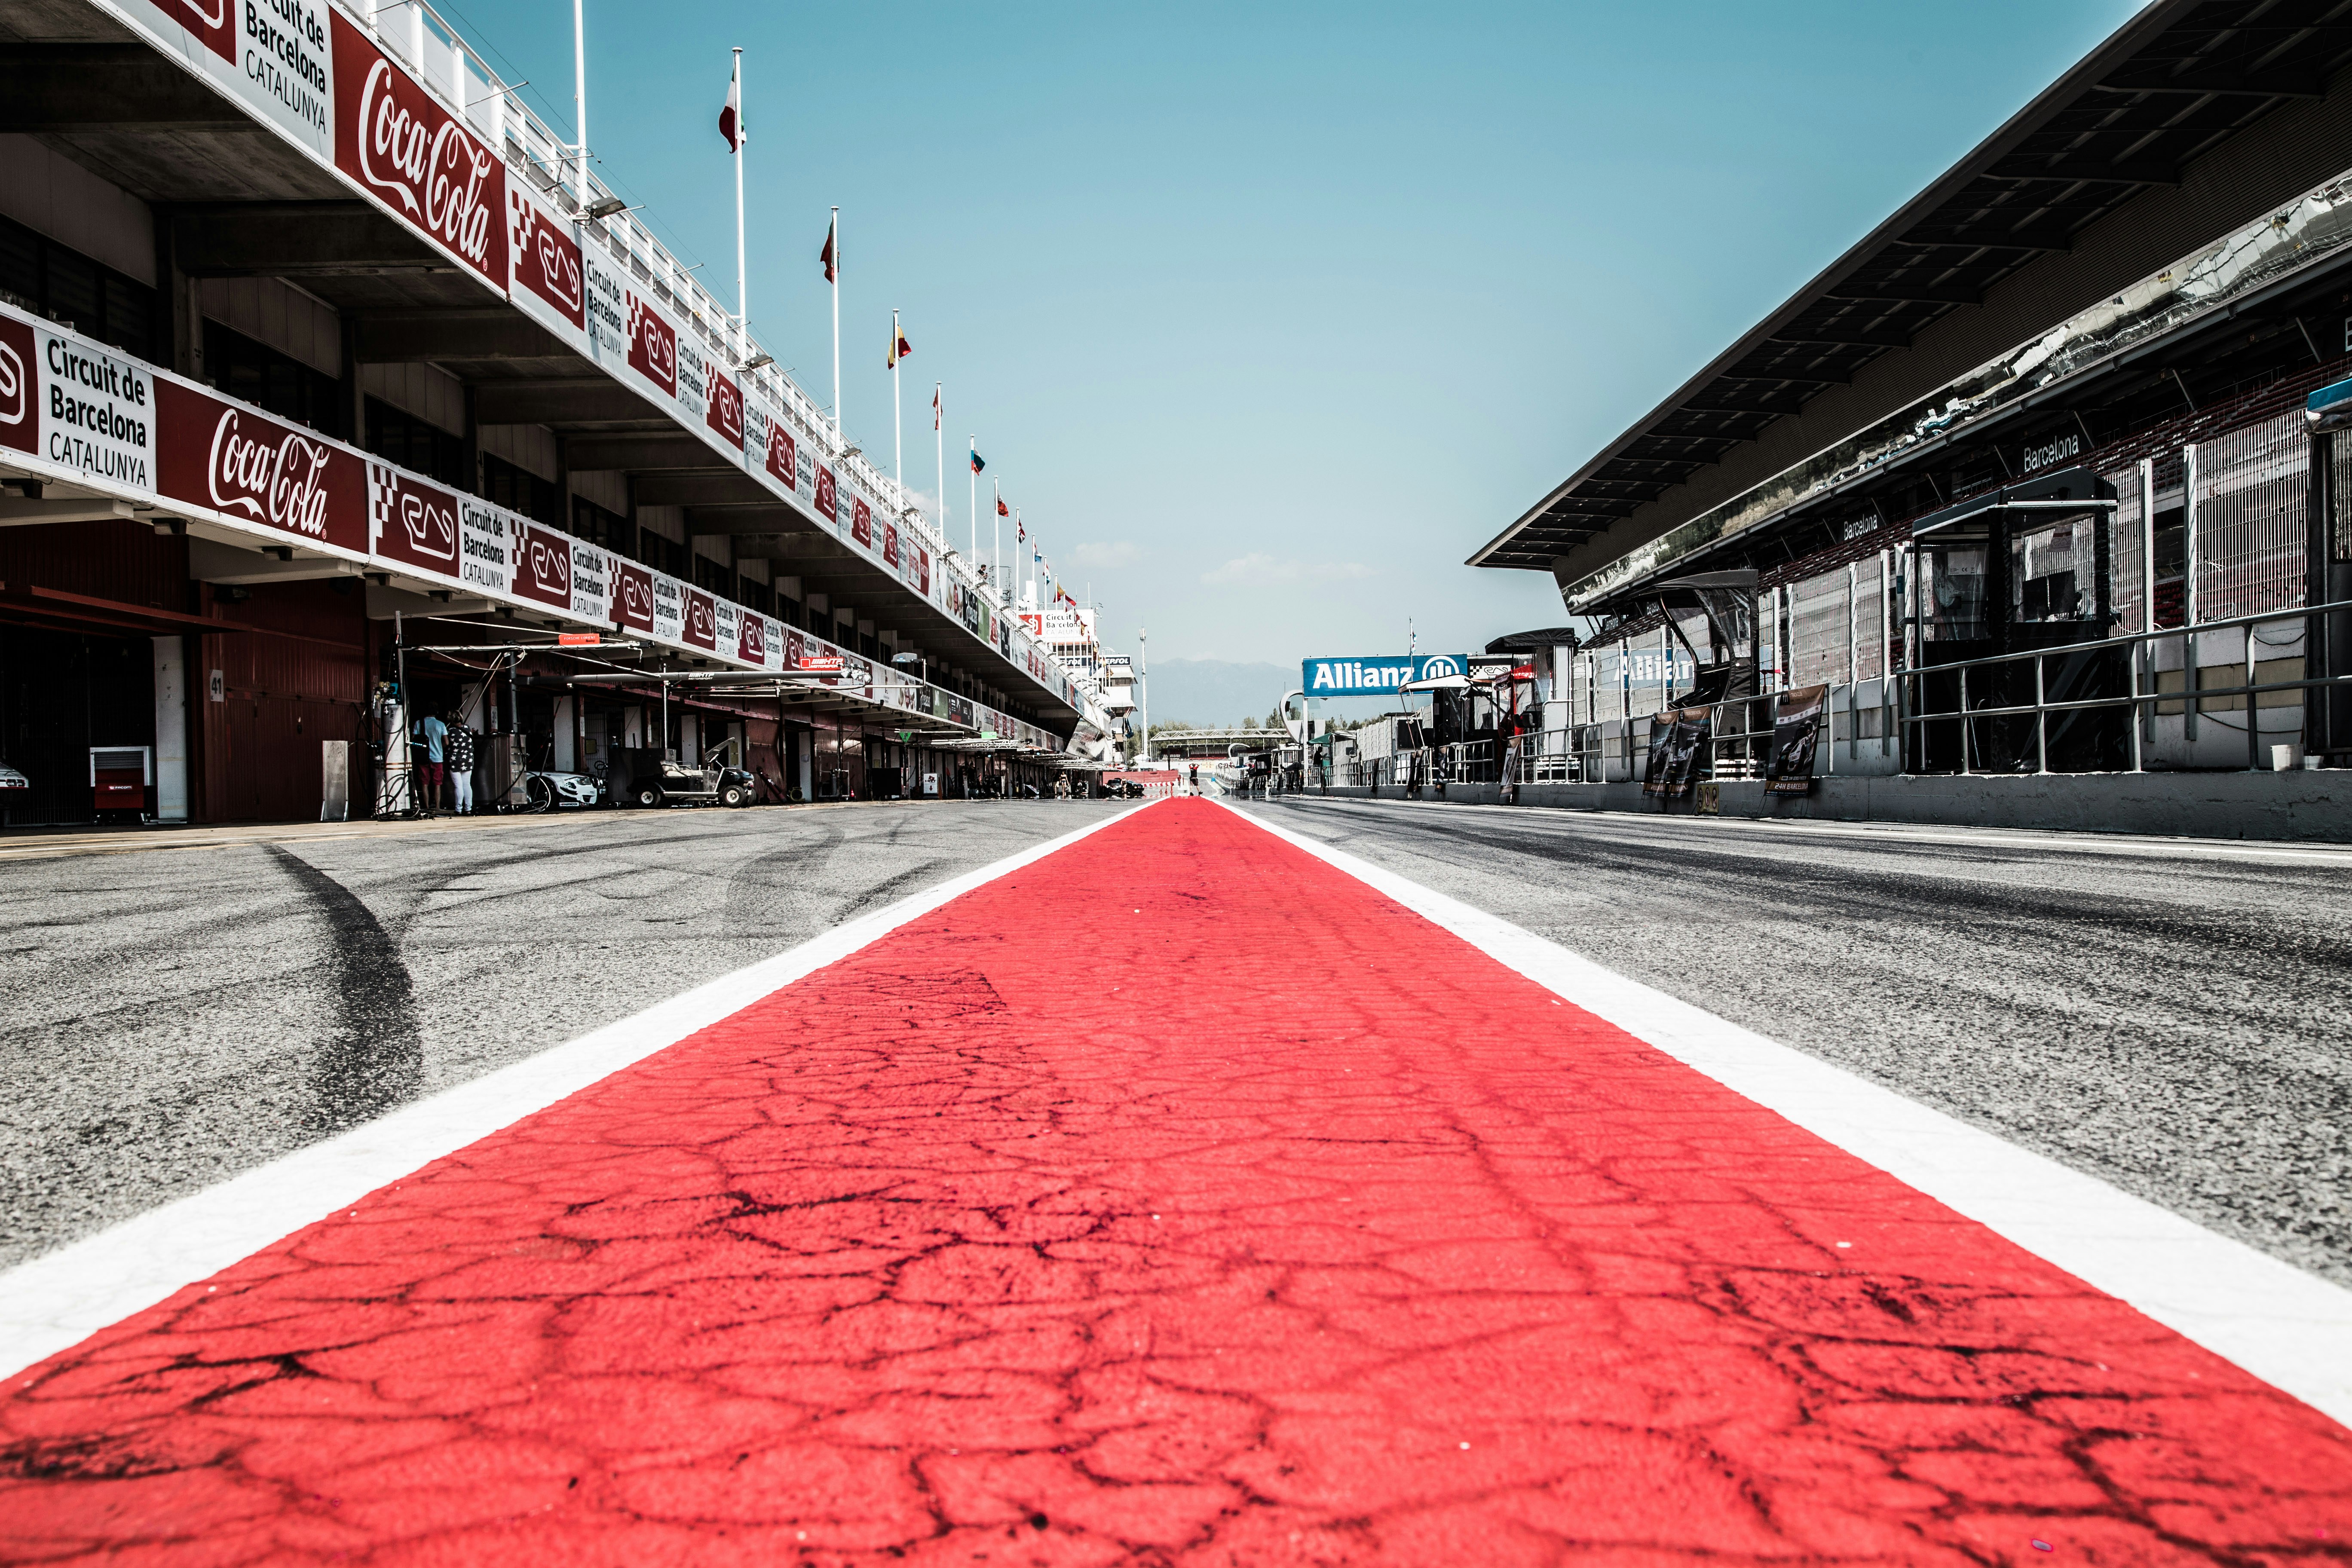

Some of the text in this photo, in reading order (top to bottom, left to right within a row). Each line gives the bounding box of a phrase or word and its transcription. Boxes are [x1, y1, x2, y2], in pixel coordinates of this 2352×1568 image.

[306, 9, 324, 52] de
[246, 0, 325, 95] Barcelona
[246, 49, 326, 135] CATALUNYA
[358, 58, 492, 263] Coca-Cola
[587, 259, 620, 306] Circuit de
[588, 287, 621, 334] Barcelona
[588, 318, 621, 359] CATALUNYA
[678, 337, 702, 375] Circuit de
[48, 339, 145, 406] Circuit de
[679, 361, 703, 398] Barcelona
[50, 383, 146, 448] Barcelona
[679, 387, 703, 420] CATALUNYA
[745, 398, 765, 429] Circuit de
[746, 419, 765, 449] Barcelona
[50, 432, 147, 487] CATALUNYA
[745, 442, 765, 469] CATALUNYA
[796, 444, 812, 470] Circuit de
[2024, 434, 2079, 473] Barcelona
[208, 408, 331, 536] Coca-Cola
[797, 462, 812, 487] Barcelona
[462, 502, 503, 538] Circuit de
[1844, 514, 1877, 540] Barcelona
[464, 531, 504, 565] Barcelona
[573, 545, 603, 574] Circuit de
[464, 562, 504, 591] CATALUNYA
[574, 570, 603, 597] Barcelona
[654, 577, 677, 600] Circuit de
[573, 596, 603, 619] CATALUNYA
[655, 599, 677, 621] Barcelona
[716, 602, 733, 622] Circuit de
[656, 621, 677, 640] CATALUNYA
[717, 621, 734, 640] Barcelona
[211, 677, 221, 694] 41
[1313, 662, 1414, 689] Allianz
